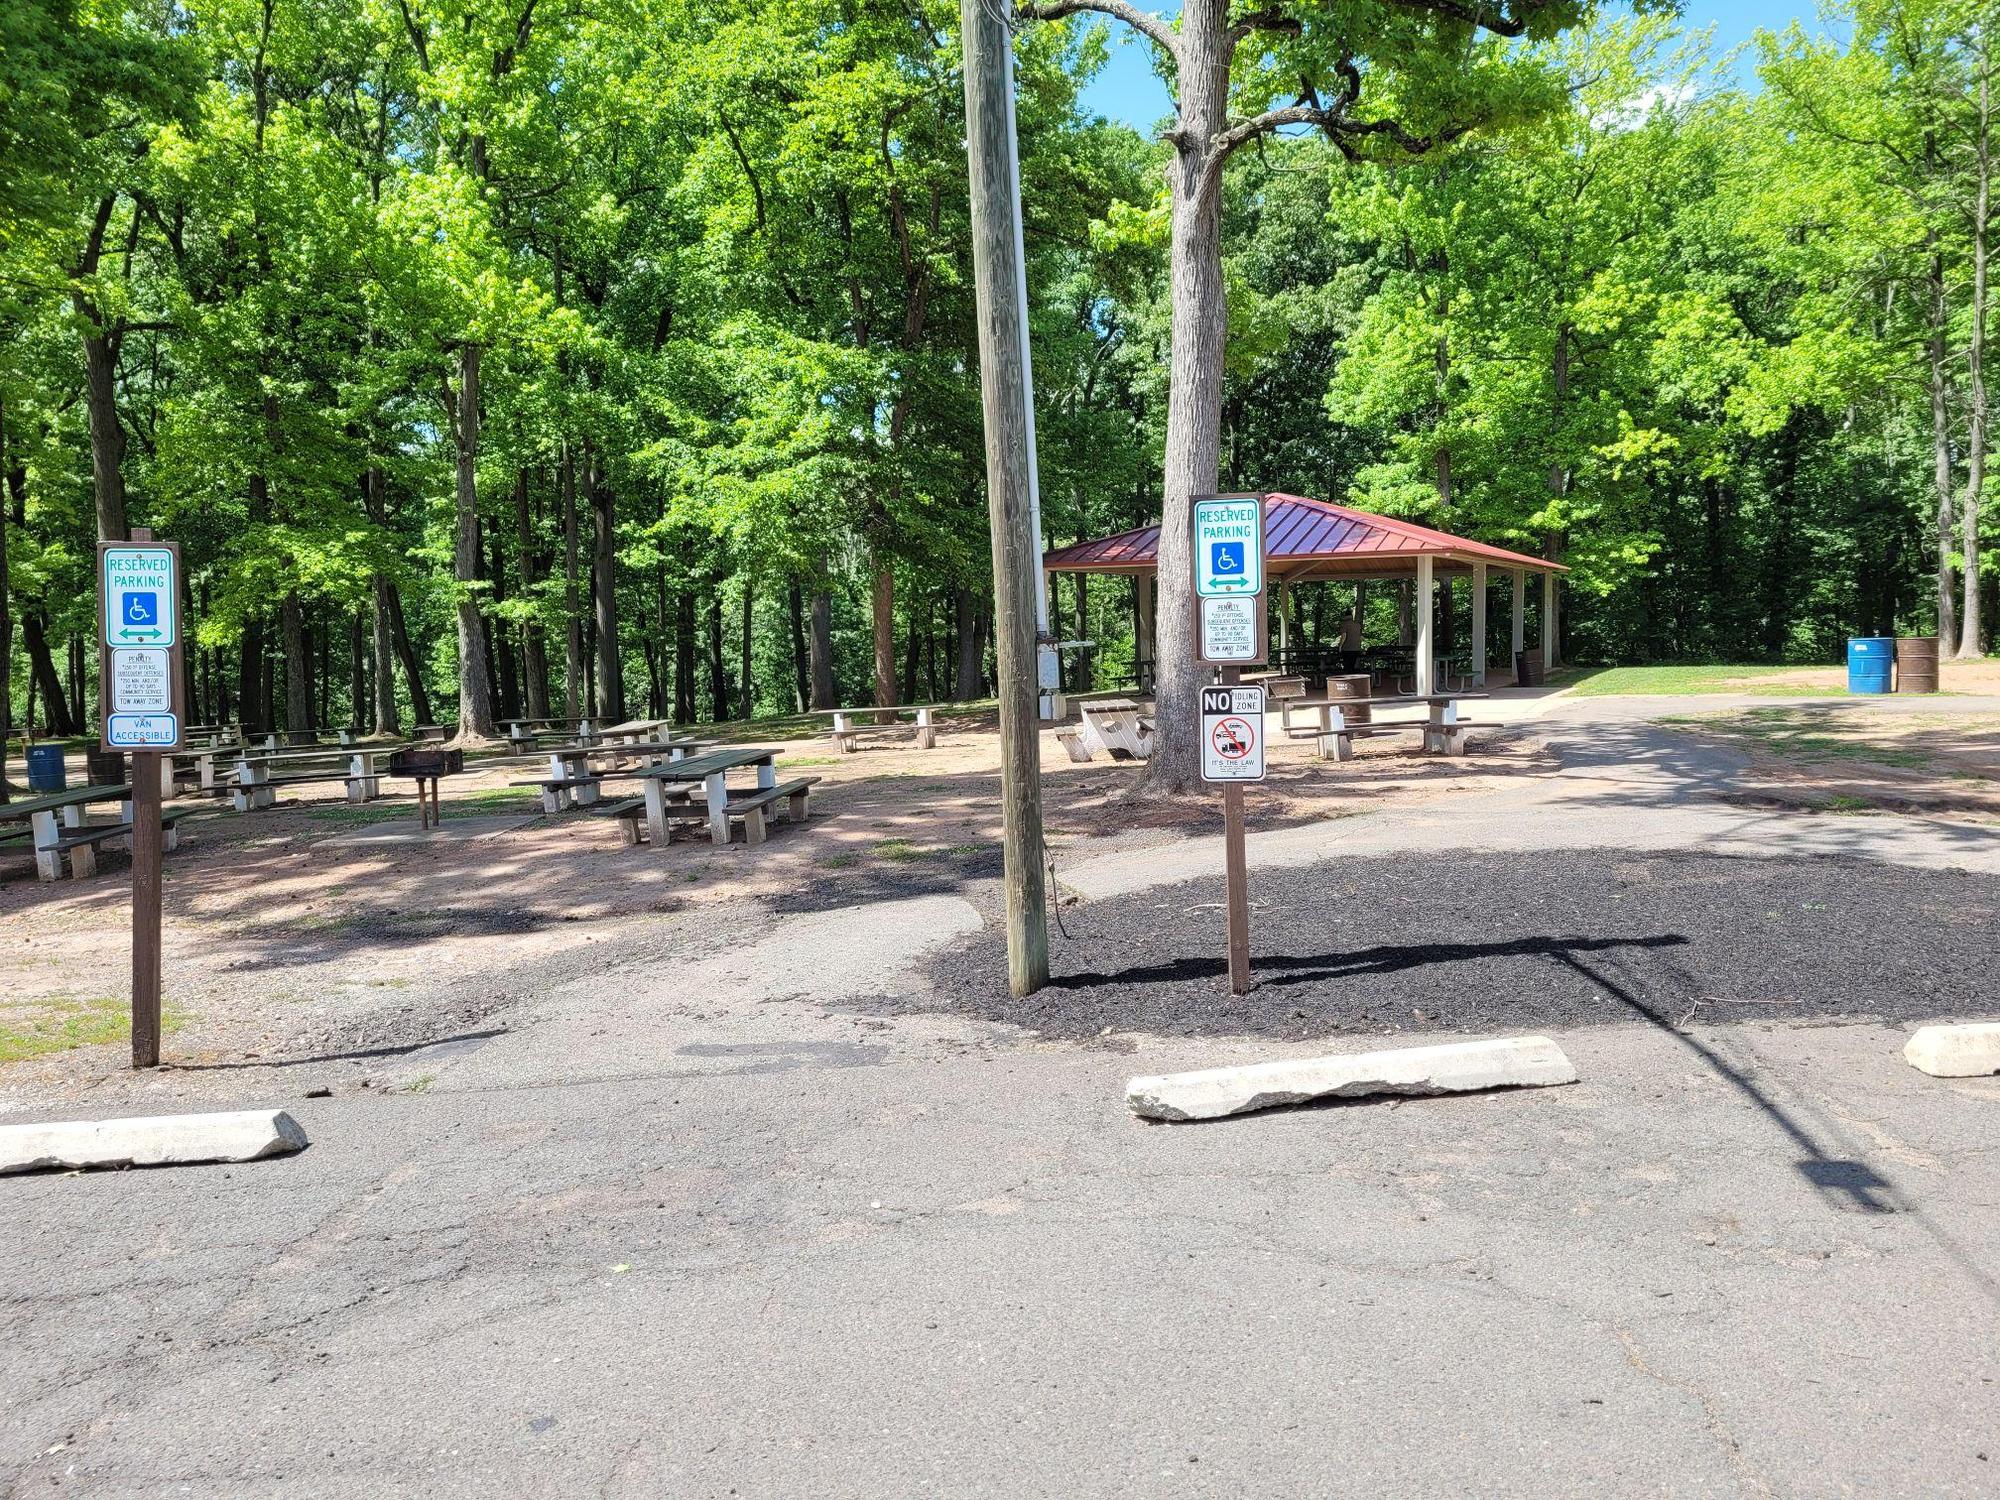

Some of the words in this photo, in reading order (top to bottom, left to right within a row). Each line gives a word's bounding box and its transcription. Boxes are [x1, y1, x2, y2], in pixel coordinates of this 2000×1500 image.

[1199, 509, 1254, 523] RESERVED
[1203, 525, 1251, 538] PARKING
[110, 558, 168, 571] RESERVED
[114, 575, 164, 588] PARKING
[120, 697, 131, 705] TOW
[132, 697, 146, 705] AWAY
[148, 697, 163, 705] ZONE
[1204, 692, 1230, 711] NO
[1234, 692, 1258, 700] IDLING
[1236, 701, 1257, 710] ZONE
[134, 720, 152, 728] VAN
[116, 731, 171, 740] ACCESSIBLE
